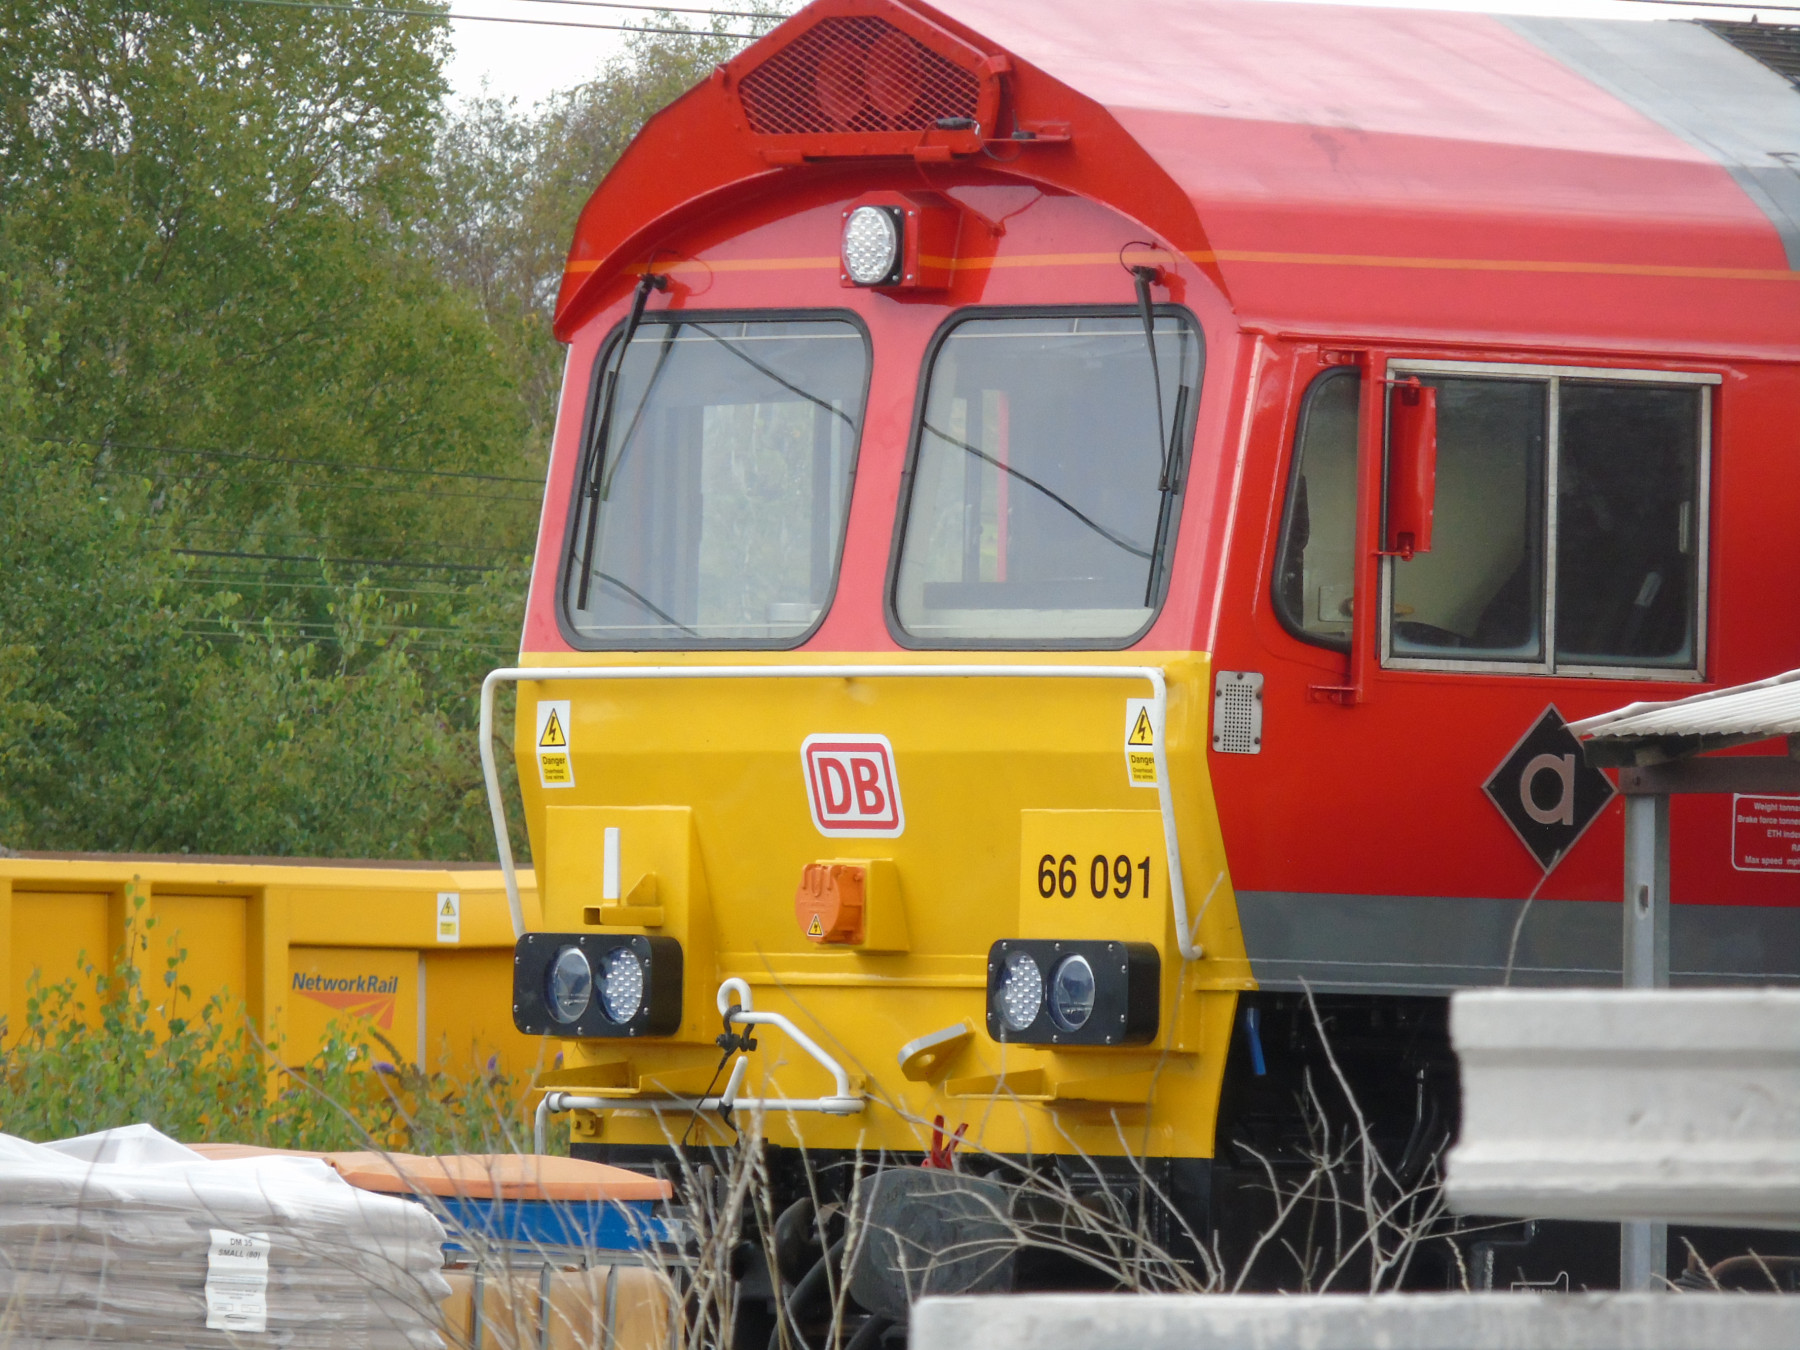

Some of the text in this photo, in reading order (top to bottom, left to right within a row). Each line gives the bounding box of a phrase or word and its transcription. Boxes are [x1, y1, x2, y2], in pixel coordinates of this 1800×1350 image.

[542, 756, 565, 766] Danger
[818, 757, 885, 815] DB
[1753, 802, 1800, 813] Weight tonne
[1737, 814, 1800, 826] Brake force tonne
[1766, 829, 1782, 838] ETH
[1744, 855, 1760, 864] Max
[1761, 857, 1783, 867] speed
[1038, 854, 1150, 899] 66 091
[230, 1238, 242, 1246] DM
[218, 1248, 244, 1258] SMALL
